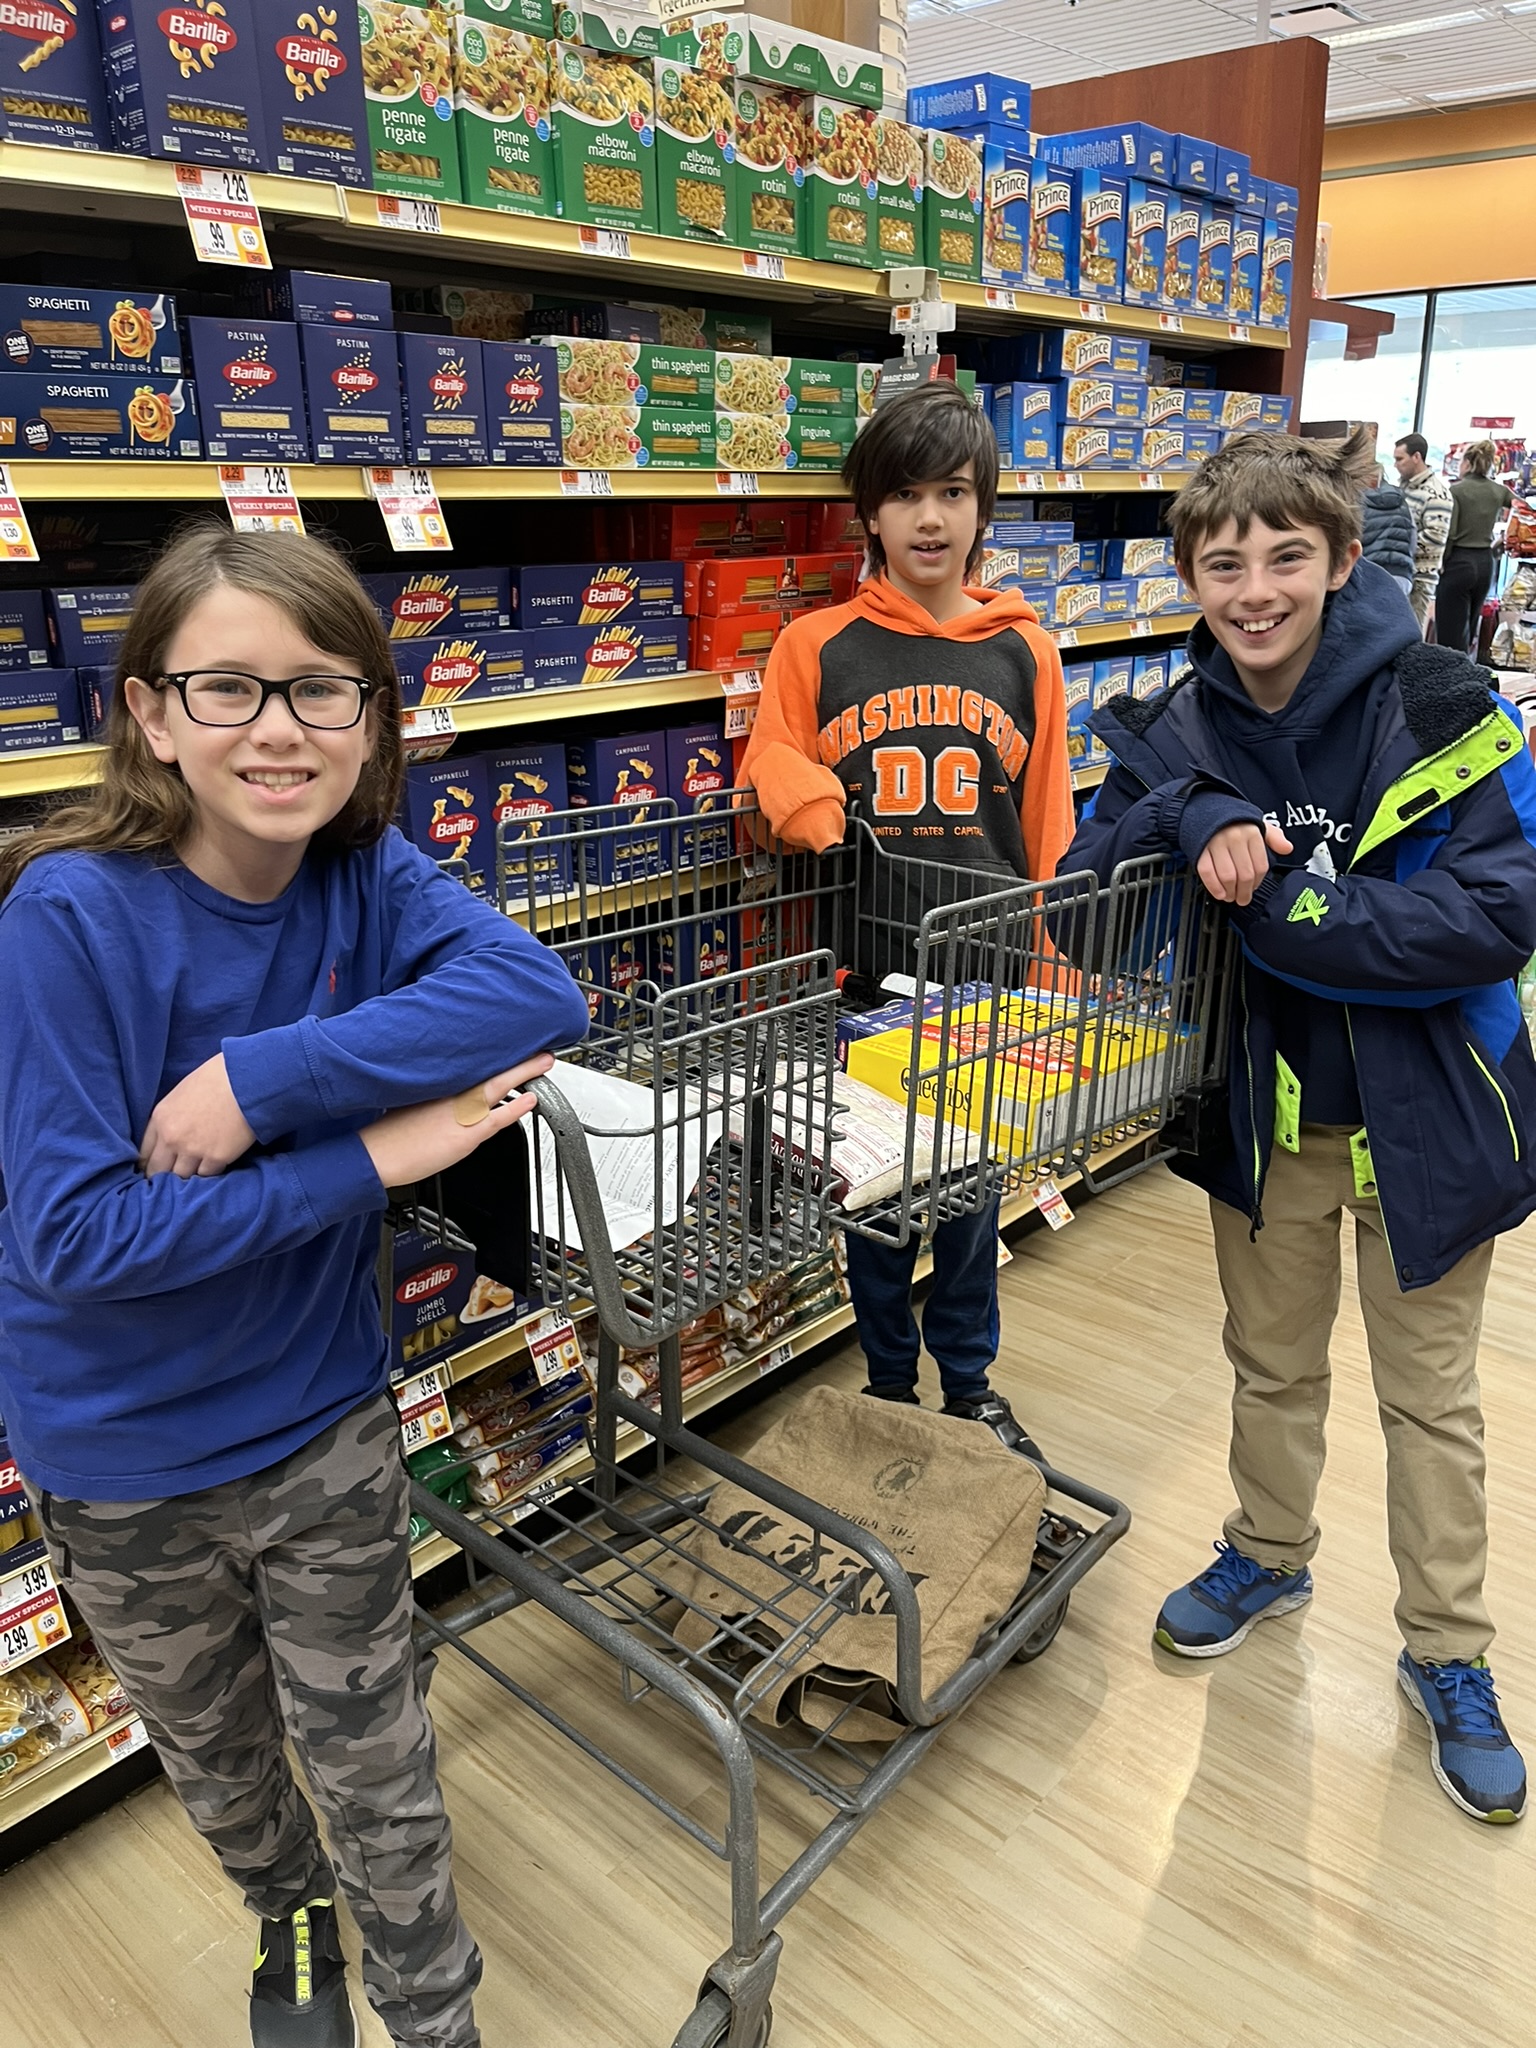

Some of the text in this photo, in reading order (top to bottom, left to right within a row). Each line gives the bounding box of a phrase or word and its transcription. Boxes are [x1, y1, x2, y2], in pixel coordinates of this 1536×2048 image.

[0, 3, 66, 34] Barilla
[169, 15, 228, 44] Barilla
[286, 42, 338, 68] Barilla
[382, 108, 426, 127] penne
[385, 125, 427, 146] rigate
[493, 128, 530, 147] penne
[595, 133, 629, 150] elbow
[495, 142, 530, 163] rigate
[588, 145, 637, 162] macaroni
[686, 149, 715, 166] elbow
[680, 160, 721, 178] macaroni
[223, 172, 249, 202] 2.29
[761, 178, 786, 195] rotini
[994, 175, 1027, 198] Prince
[837, 192, 861, 208] rotini
[879, 194, 916, 212] small shells
[1038, 188, 1068, 210] Prince
[1089, 198, 1119, 218] Prince
[189, 204, 255, 220] WEEKLY SPECIAL
[940, 207, 974, 224] small shells
[1135, 206, 1163, 228] Prince
[1170, 216, 1197, 238] Prince
[1203, 225, 1229, 245] Prince
[1269, 243, 1291, 261] Prince
[28, 296, 91, 311] SPAGHETTI
[6, 336, 28, 347] ONE
[227, 331, 266, 342] PASTINA
[336, 338, 370, 350] PASTINA
[437, 347, 455, 356] ORZO
[514, 353, 532, 362] ORZO
[1079, 340, 1109, 364] Prince
[230, 365, 272, 381] Barilla
[651, 357, 711, 375] thin spaghetti
[338, 371, 375, 386] Barilla
[434, 378, 464, 392] Barilla
[800, 369, 832, 386] linguine
[882, 374, 902, 383] MAGIC
[47, 385, 109, 398] SPAGHETTI
[510, 383, 540, 396] Barilla
[1026, 393, 1049, 412] Prince
[1082, 389, 1111, 412] Prince
[1152, 395, 1182, 417] Prince
[1235, 400, 1259, 421] Prince
[25, 424, 47, 435] ONE
[652, 419, 711, 436] thin spaghetti
[800, 425, 831, 440] linguine
[1079, 435, 1107, 459] Prince
[1153, 437, 1181, 459] Prince
[264, 466, 288, 495] 2.29
[233, 502, 294, 511] WEEKLY SPECIAL
[1061, 551, 1079, 571] Prince
[1136, 546, 1163, 567] Prince
[984, 554, 1017, 580] Prince
[531, 596, 574, 607] SPAGHETTI
[588, 587, 626, 603] Barilla
[1069, 589, 1099, 613] Prince
[1150, 583, 1176, 608] Prince
[400, 597, 445, 615] Barilla
[534, 656, 577, 669] SPAGHETTI
[591, 646, 630, 663] Barilla
[431, 663, 473, 682] Barilla
[1139, 670, 1160, 693] Prince
[1099, 676, 1127, 702] Prince
[685, 733, 718, 745] CAMPANELLE
[817, 684, 1030, 783] WASHINGTON
[615, 744, 650, 757] CAMPANELLE
[495, 757, 543, 769] CAMPANELLE
[430, 770, 469, 784] CAMPANELLE
[688, 776, 720, 793] Barilla
[872, 746, 981, 816] DC
[619, 787, 653, 804] Barilla
[501, 803, 548, 820] Barilla
[436, 818, 474, 839] Barilla
[872, 826, 985, 837] UNITED STATES CAPITAL
[404, 1268, 451, 1300] Barilla
[416, 1306, 447, 1326] SHELLS
[417, 1297, 445, 1317] JUMBO
[534, 1340, 553, 1352] WEEKLY
[542, 1350, 558, 1373] 2.99
[419, 1372, 437, 1397] 3.99
[419, 1397, 442, 1411] SPECIAL
[560, 1408, 574, 1420] Fine
[405, 1419, 422, 1443] 2.99
[557, 1434, 572, 1447] Fine
[22, 1564, 48, 1596] 3.99
[0, 1593, 55, 1628] EEKLY SPECIAL
[43, 1617, 56, 1630] 1.00
[4, 1625, 29, 1656] 2.99
[296, 1948, 310, 1972] NIKE
[297, 1975, 311, 1999] NIKE
